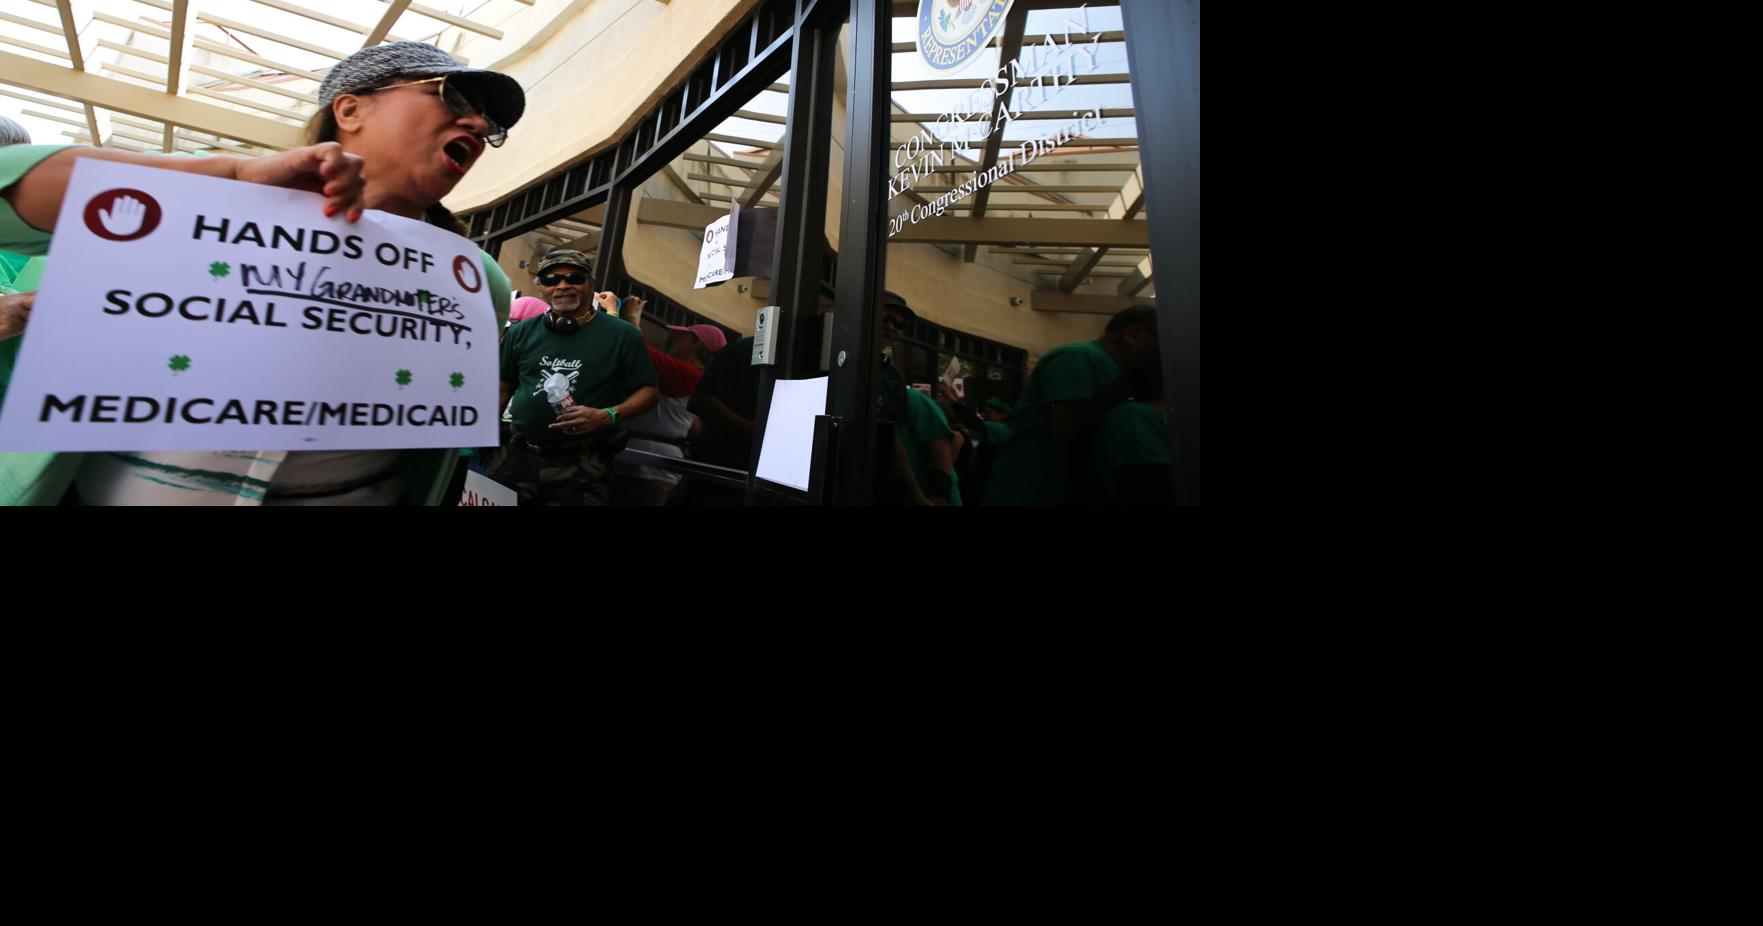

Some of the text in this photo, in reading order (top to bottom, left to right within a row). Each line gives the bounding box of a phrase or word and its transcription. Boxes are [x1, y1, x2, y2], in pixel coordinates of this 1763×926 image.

[887, 142, 945, 200] KEVIN
[888, 107, 1105, 238] 20th Congressional District
[192, 213, 435, 274] HANDS OFF
[240, 261, 306, 291] MY
[102, 289, 472, 350] SOCIAL SECURITY,
[539, 355, 583, 372] Softball
[38, 394, 479, 428] MEDICARE/MEDICAID
